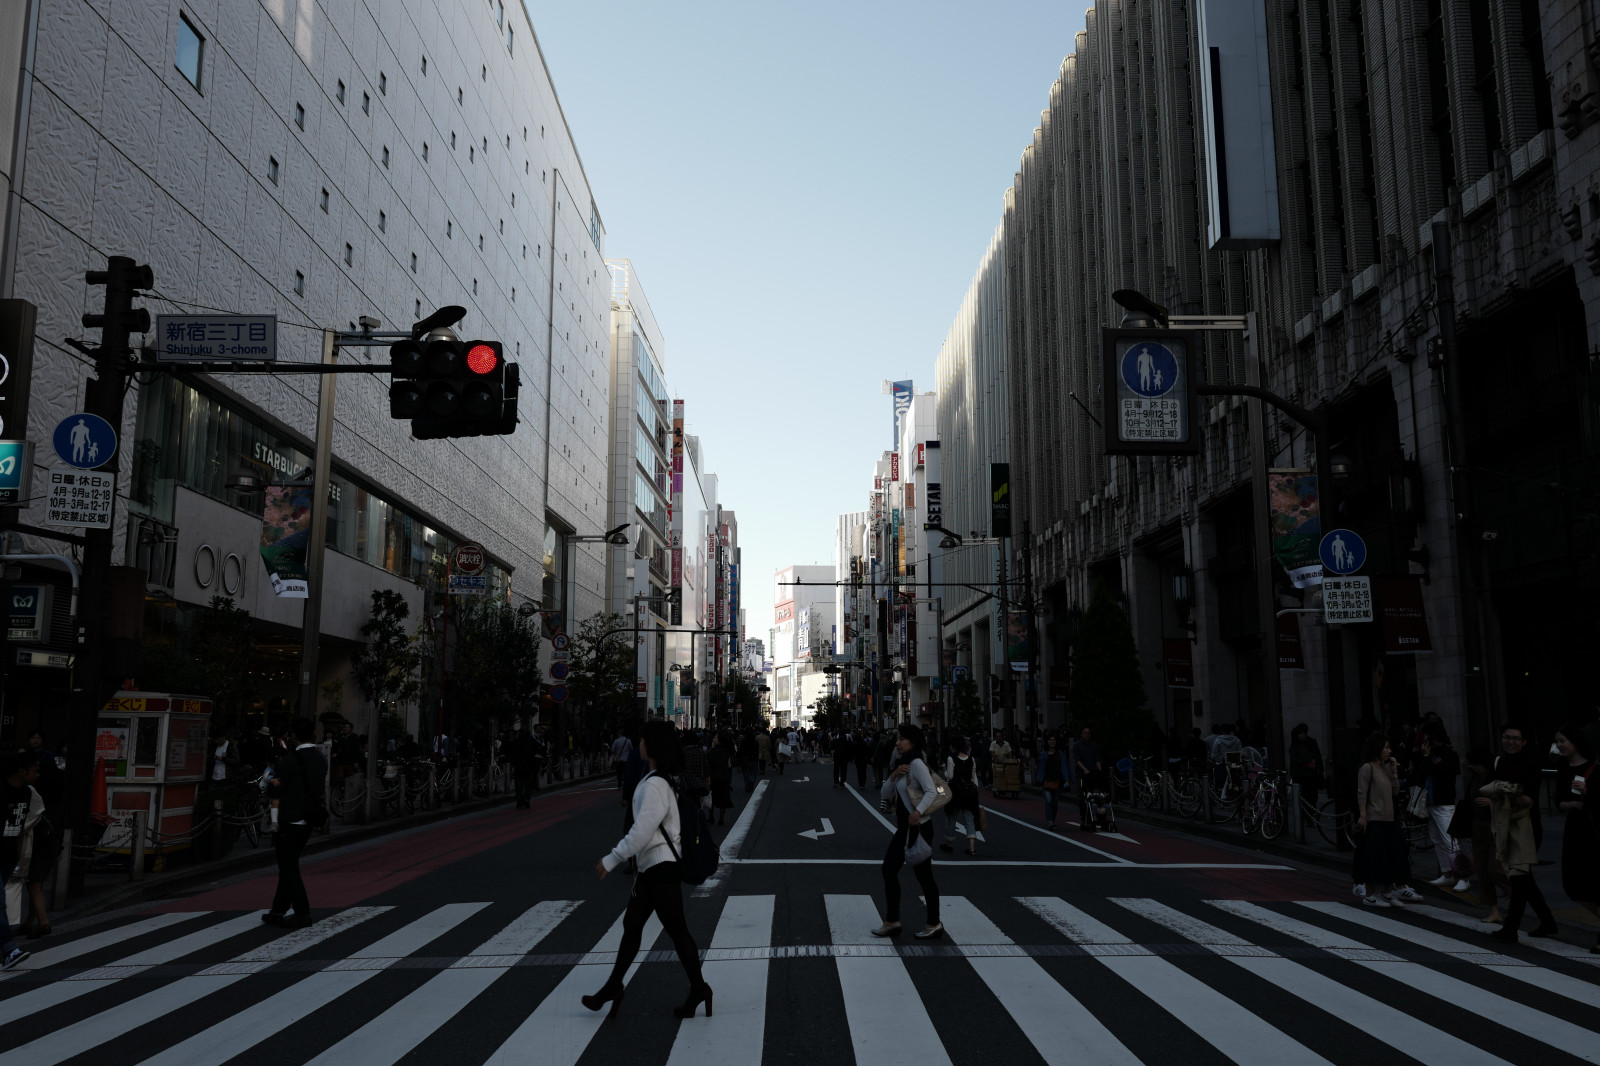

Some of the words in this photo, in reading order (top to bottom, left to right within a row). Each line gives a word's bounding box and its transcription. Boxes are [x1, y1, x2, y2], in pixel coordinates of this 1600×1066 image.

[166, 322, 266, 342] 新宿三丁目
[166, 344, 212, 357] Shinjuku
[218, 344, 268, 355] 3-chome
[51, 473, 111, 488] 日曜・休日の
[48, 510, 109, 524] (特定禁止区域)
[459, 554, 481, 564] 消火栓
[1324, 581, 1367, 590] 日曜・休日の
